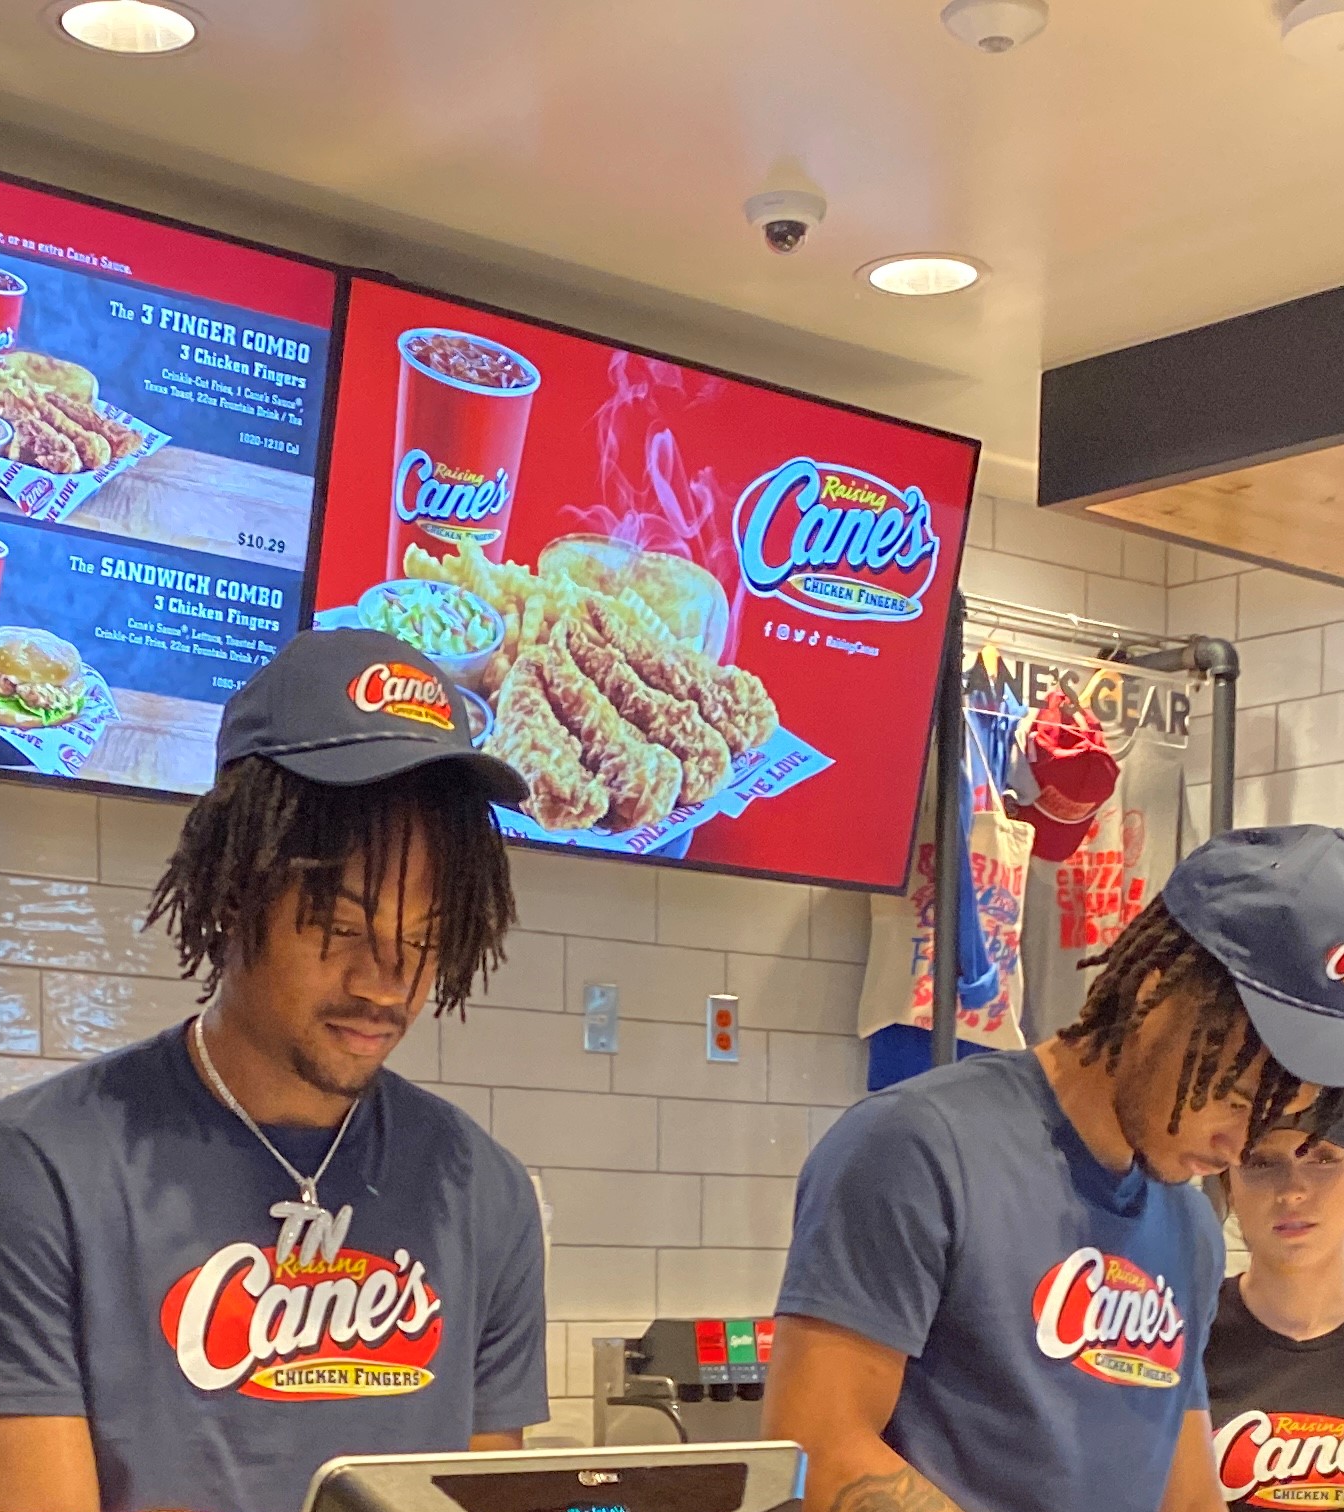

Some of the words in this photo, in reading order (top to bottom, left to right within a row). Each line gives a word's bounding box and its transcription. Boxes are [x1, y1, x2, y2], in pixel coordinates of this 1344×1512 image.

[8, 235, 20, 246] or
[38, 243, 63, 257] extra
[110, 301, 134, 321] The
[141, 303, 154, 325] 3
[159, 307, 237, 346] FINGER
[242, 329, 311, 364] COMBO
[161, 368, 209, 390] Crinkle-Cut
[180, 344, 191, 360] 3
[193, 347, 249, 376] Chicken
[253, 361, 307, 389] Fingers
[395, 448, 511, 522] Cane's
[433, 462, 484, 488] Raising
[821, 475, 887, 513] Raising
[238, 532, 286, 554] $10.29
[743, 460, 935, 590] Cane's
[69, 555, 95, 574] The
[100, 556, 211, 596] SANDWICH
[216, 579, 283, 609] COMBO
[154, 595, 164, 611] 3
[168, 596, 223, 622] Chicken
[227, 609, 280, 632] Fingers
[1106, 1260, 1147, 1293] Raising
[176, 1242, 442, 1391] Cane's
[1036, 1247, 1184, 1359] Cane's
